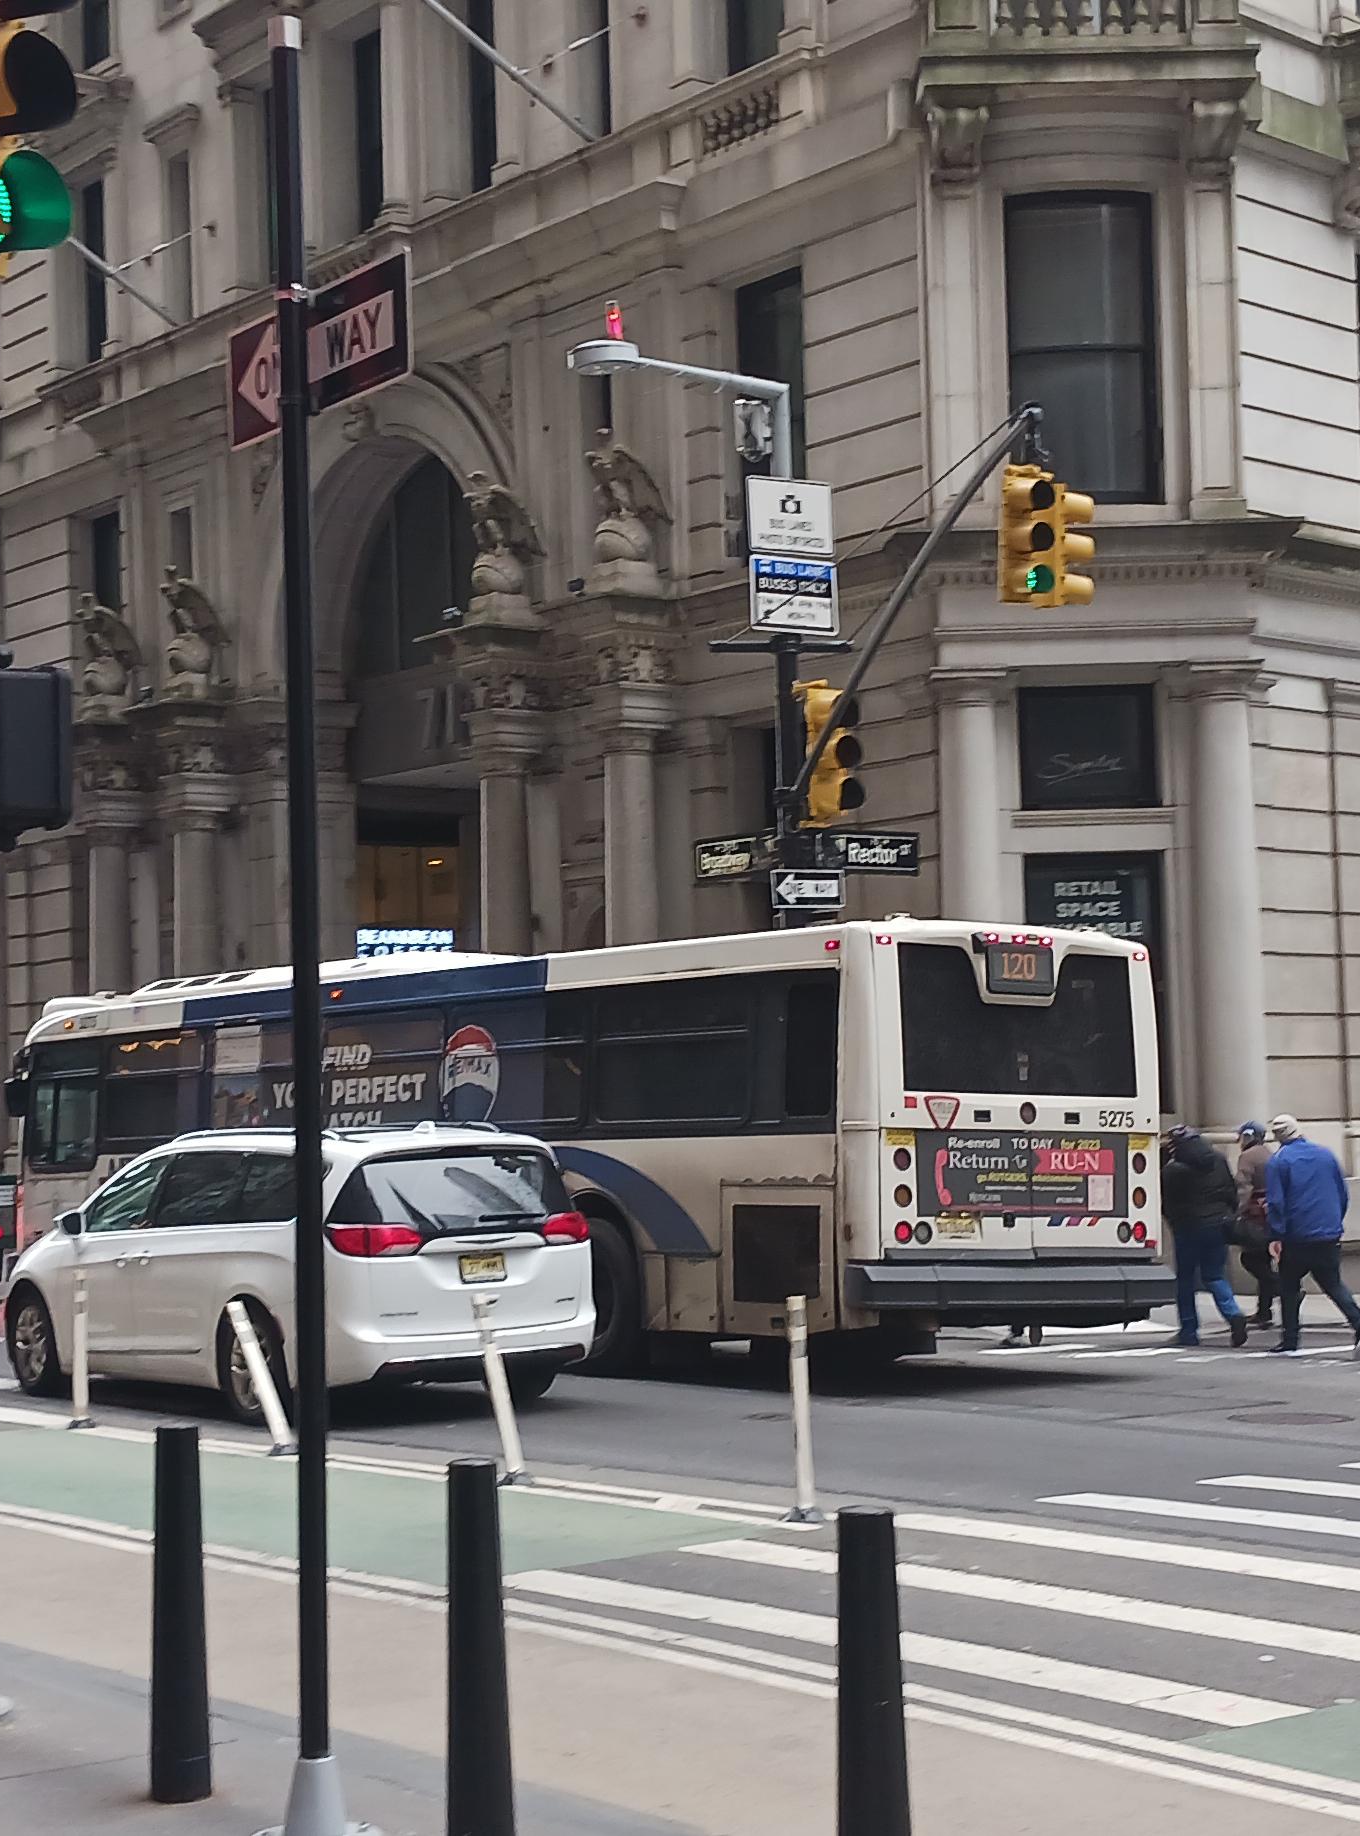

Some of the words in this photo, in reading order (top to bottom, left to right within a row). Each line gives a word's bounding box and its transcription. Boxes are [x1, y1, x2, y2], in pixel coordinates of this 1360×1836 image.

[326, 302, 382, 368] WAY
[758, 577, 798, 591] BUSES
[848, 842, 899, 865] Rector
[786, 881, 805, 896] ONE
[814, 881, 833, 896] WAY
[1054, 881, 1122, 897] RETAIL
[1056, 901, 1121, 918] SPACE
[1002, 952, 1037, 980] 120
[321, 1044, 372, 1072] FIND
[331, 1073, 427, 1106] PERFECT
[1098, 1110, 1135, 1128] 5275
[948, 1151, 1009, 1169] Return
[1050, 1152, 1101, 1171] RU-N
